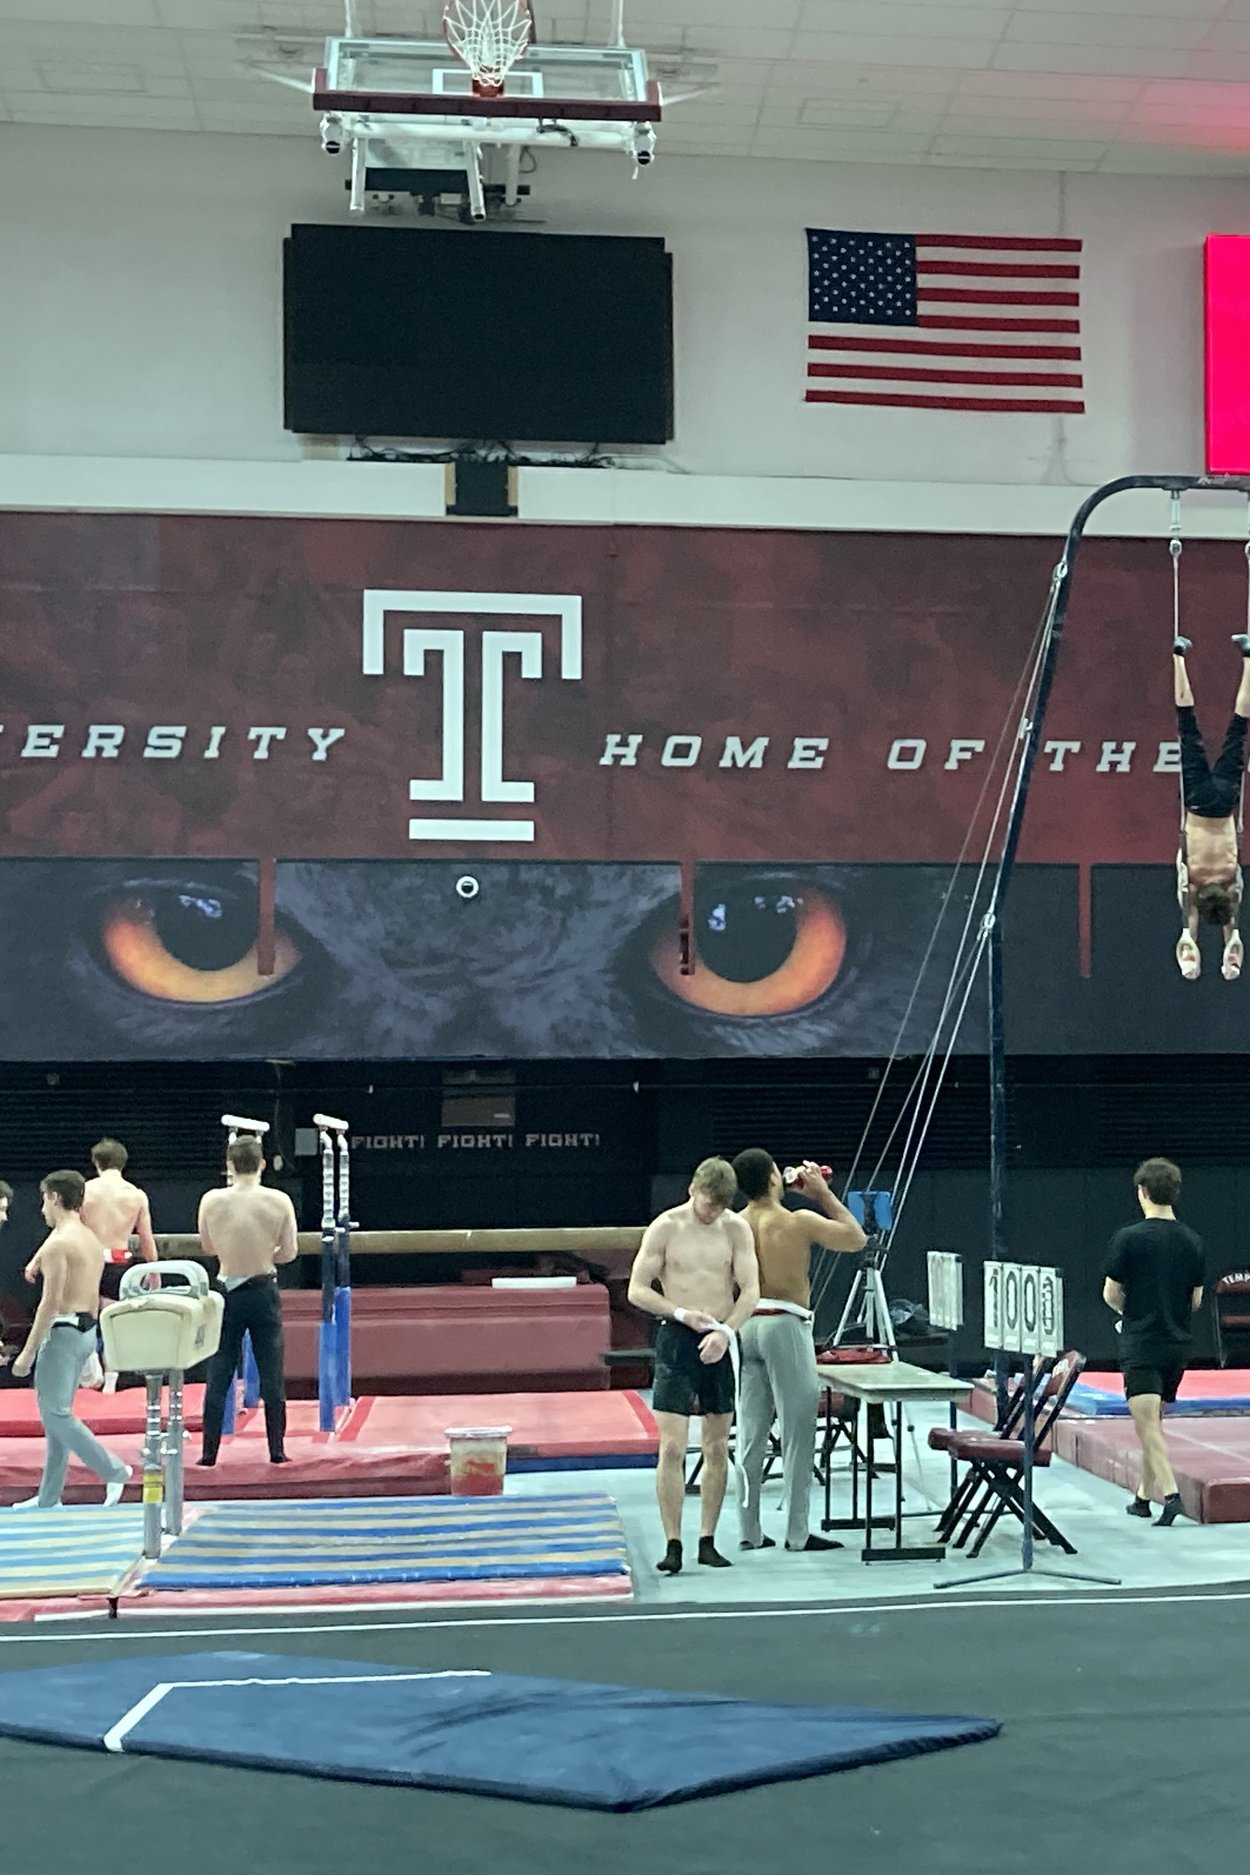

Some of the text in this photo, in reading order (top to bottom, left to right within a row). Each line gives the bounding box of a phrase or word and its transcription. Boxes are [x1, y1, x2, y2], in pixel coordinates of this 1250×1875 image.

[362, 588, 584, 842] T
[0, 724, 345, 761] ERSITY
[599, 734, 829, 768] HOME
[887, 739, 985, 770] OF
[1044, 740, 1183, 773] THE
[351, 1133, 600, 1149] FIGHT! FIGHT! FIGHT!
